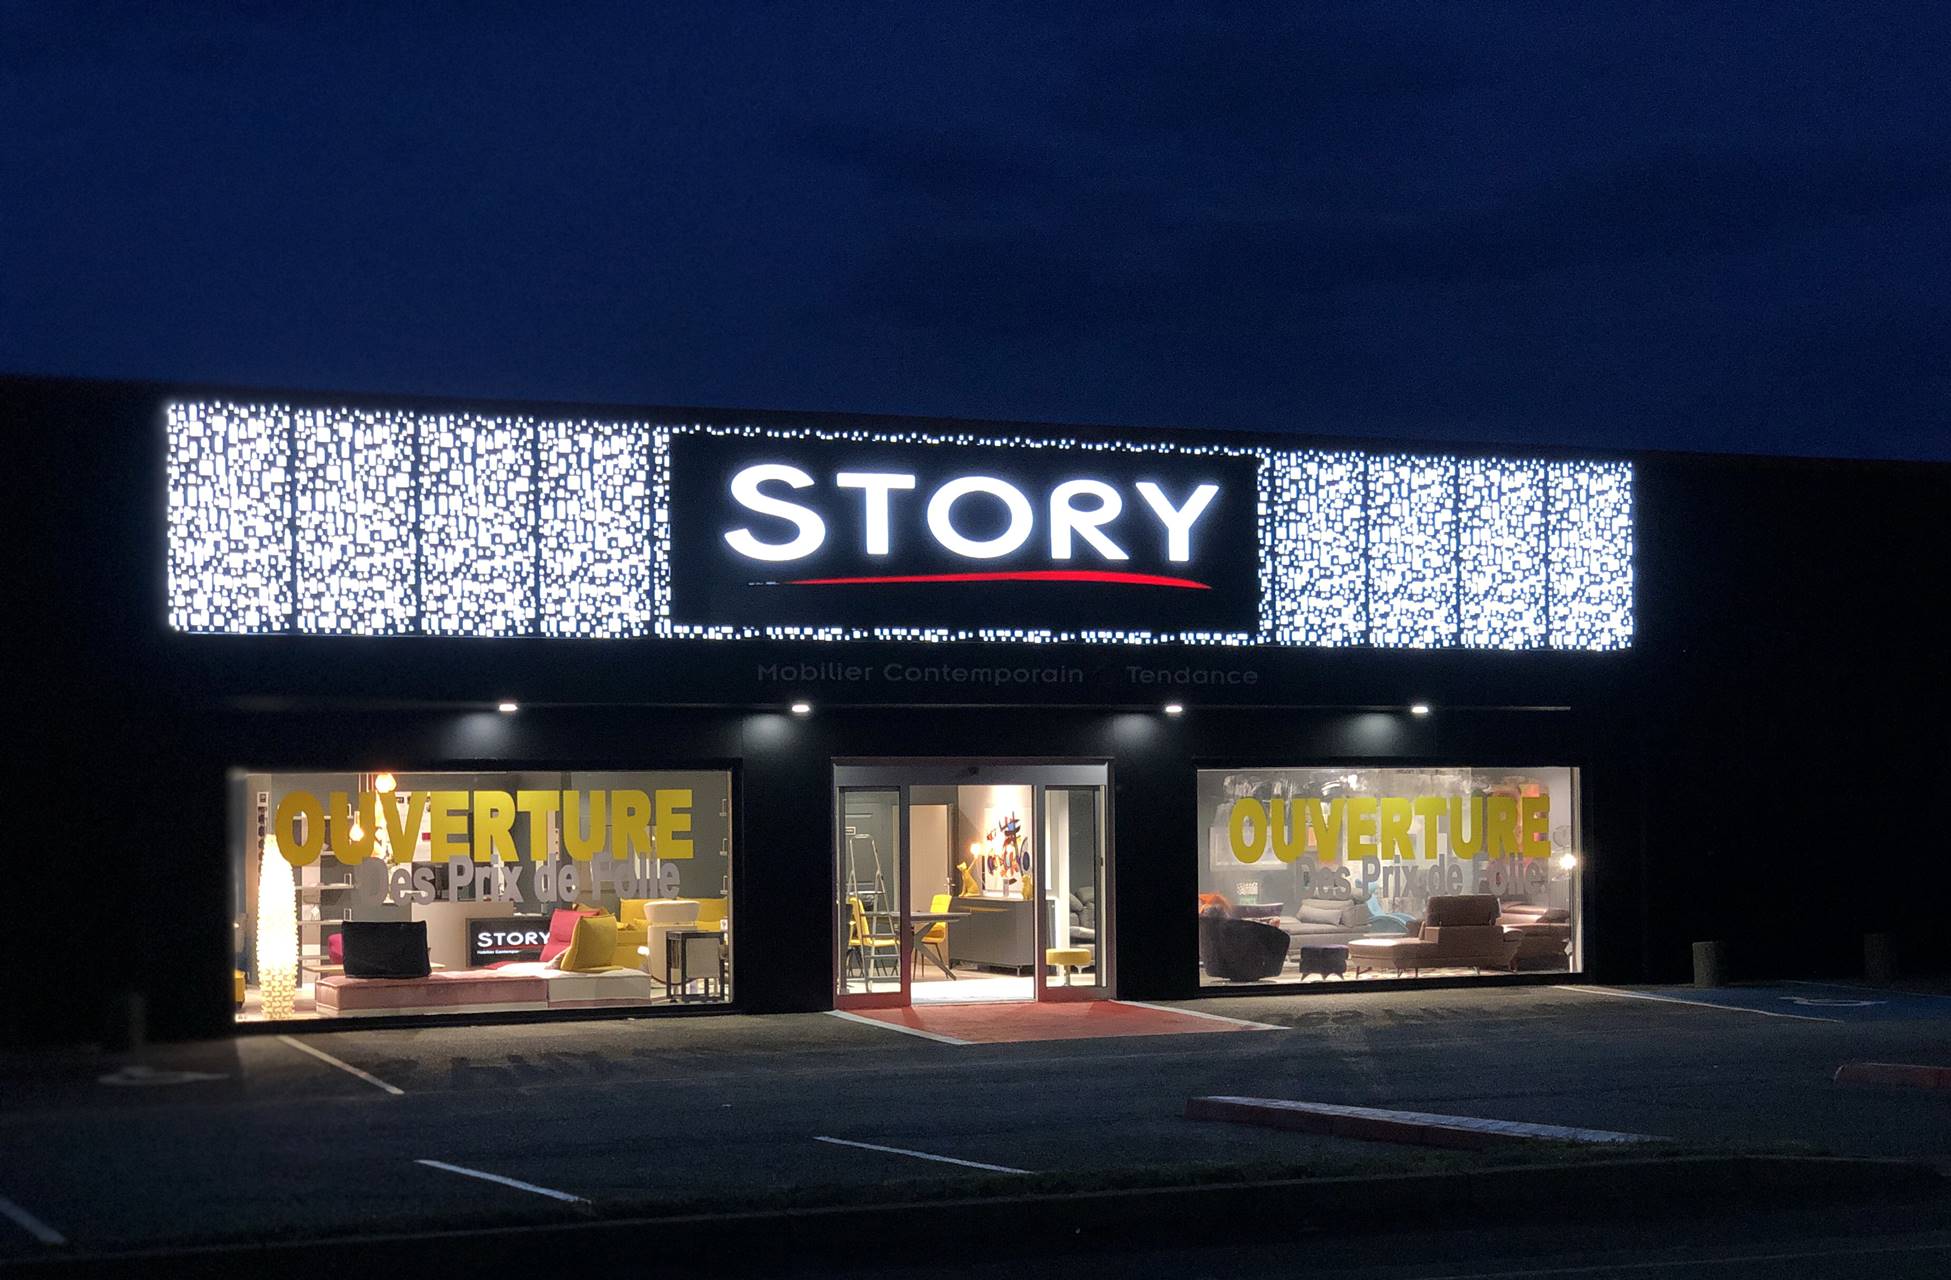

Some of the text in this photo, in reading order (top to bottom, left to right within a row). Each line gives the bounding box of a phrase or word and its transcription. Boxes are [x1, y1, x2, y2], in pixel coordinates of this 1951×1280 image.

[724, 463, 1220, 562] STORY
[757, 661, 1259, 686] Mobilier Contemporain Tendance
[275, 788, 695, 866] OUVERTURE
[1229, 795, 1552, 864] OUVERTURE
[355, 851, 681, 905] Des Prix de Folie
[1296, 852, 1545, 899] Des Prix de Folie
[477, 931, 550, 947] STORY
